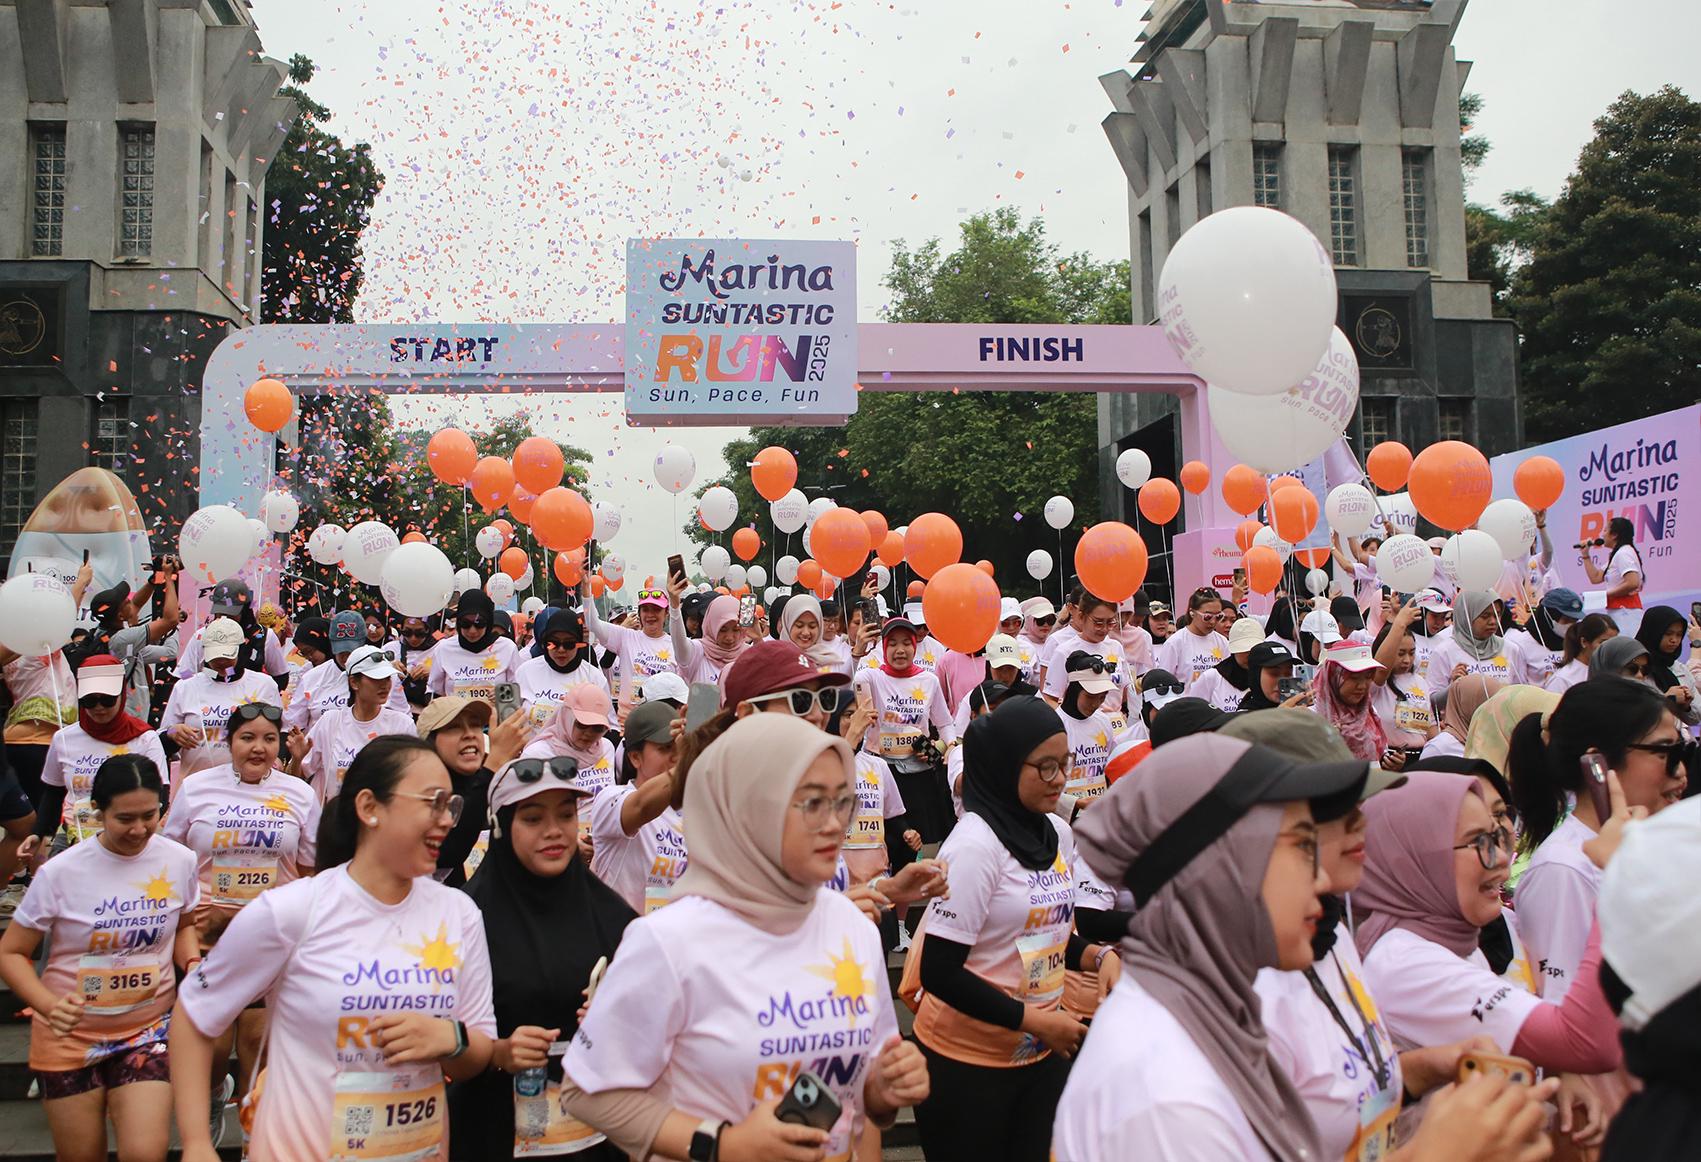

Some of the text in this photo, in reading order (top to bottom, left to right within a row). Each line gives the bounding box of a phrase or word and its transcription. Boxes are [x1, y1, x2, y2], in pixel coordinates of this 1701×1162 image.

[659, 249, 834, 299] Marina
[662, 303, 834, 325] SUNTASTIC
[390, 337, 499, 362] START
[979, 337, 1083, 361] FINISH
[653, 335, 813, 383] RUN
[809, 335, 831, 382] 2025
[649, 388, 820, 404] Sun, Pace, Fun
[1580, 438, 1678, 482] Marina
[1581, 473, 1679, 507] SUNTASTIC
[1665, 498, 1678, 539] 2025
[1649, 545, 1673, 558] Fun
[913, 658, 934, 667] arina
[455, 666, 496, 678] Marina
[886, 704, 924, 714] SUNTASTIC
[887, 694, 924, 707] Marina
[884, 711, 919, 725] RUN
[1111, 720, 1123, 729] 89
[1412, 711, 1429, 721] 1274
[77, 754, 109, 767] Mar
[576, 777, 612, 787] NTASTIC
[218, 804, 285, 819] Marina
[216, 819, 284, 829] SUNTASTIC
[858, 820, 880, 831] 1741
[212, 829, 276, 849] RUN
[650, 856, 688, 879] RU
[238, 872, 270, 885] 2126
[94, 895, 168, 916] Marina
[93, 914, 168, 930] SUNTASTIC
[1024, 902, 1075, 930] RUN
[88, 928, 159, 952] RUN
[1047, 953, 1065, 972] 10
[110, 972, 152, 990] 3165
[343, 959, 455, 990] Marina
[340, 994, 455, 1011] SUNTASTIC
[758, 990, 870, 1029] Marina
[760, 1028, 872, 1057] SUNTASTIC
[385, 1096, 437, 1127] 1526
[347, 1138, 366, 1149] 5K
